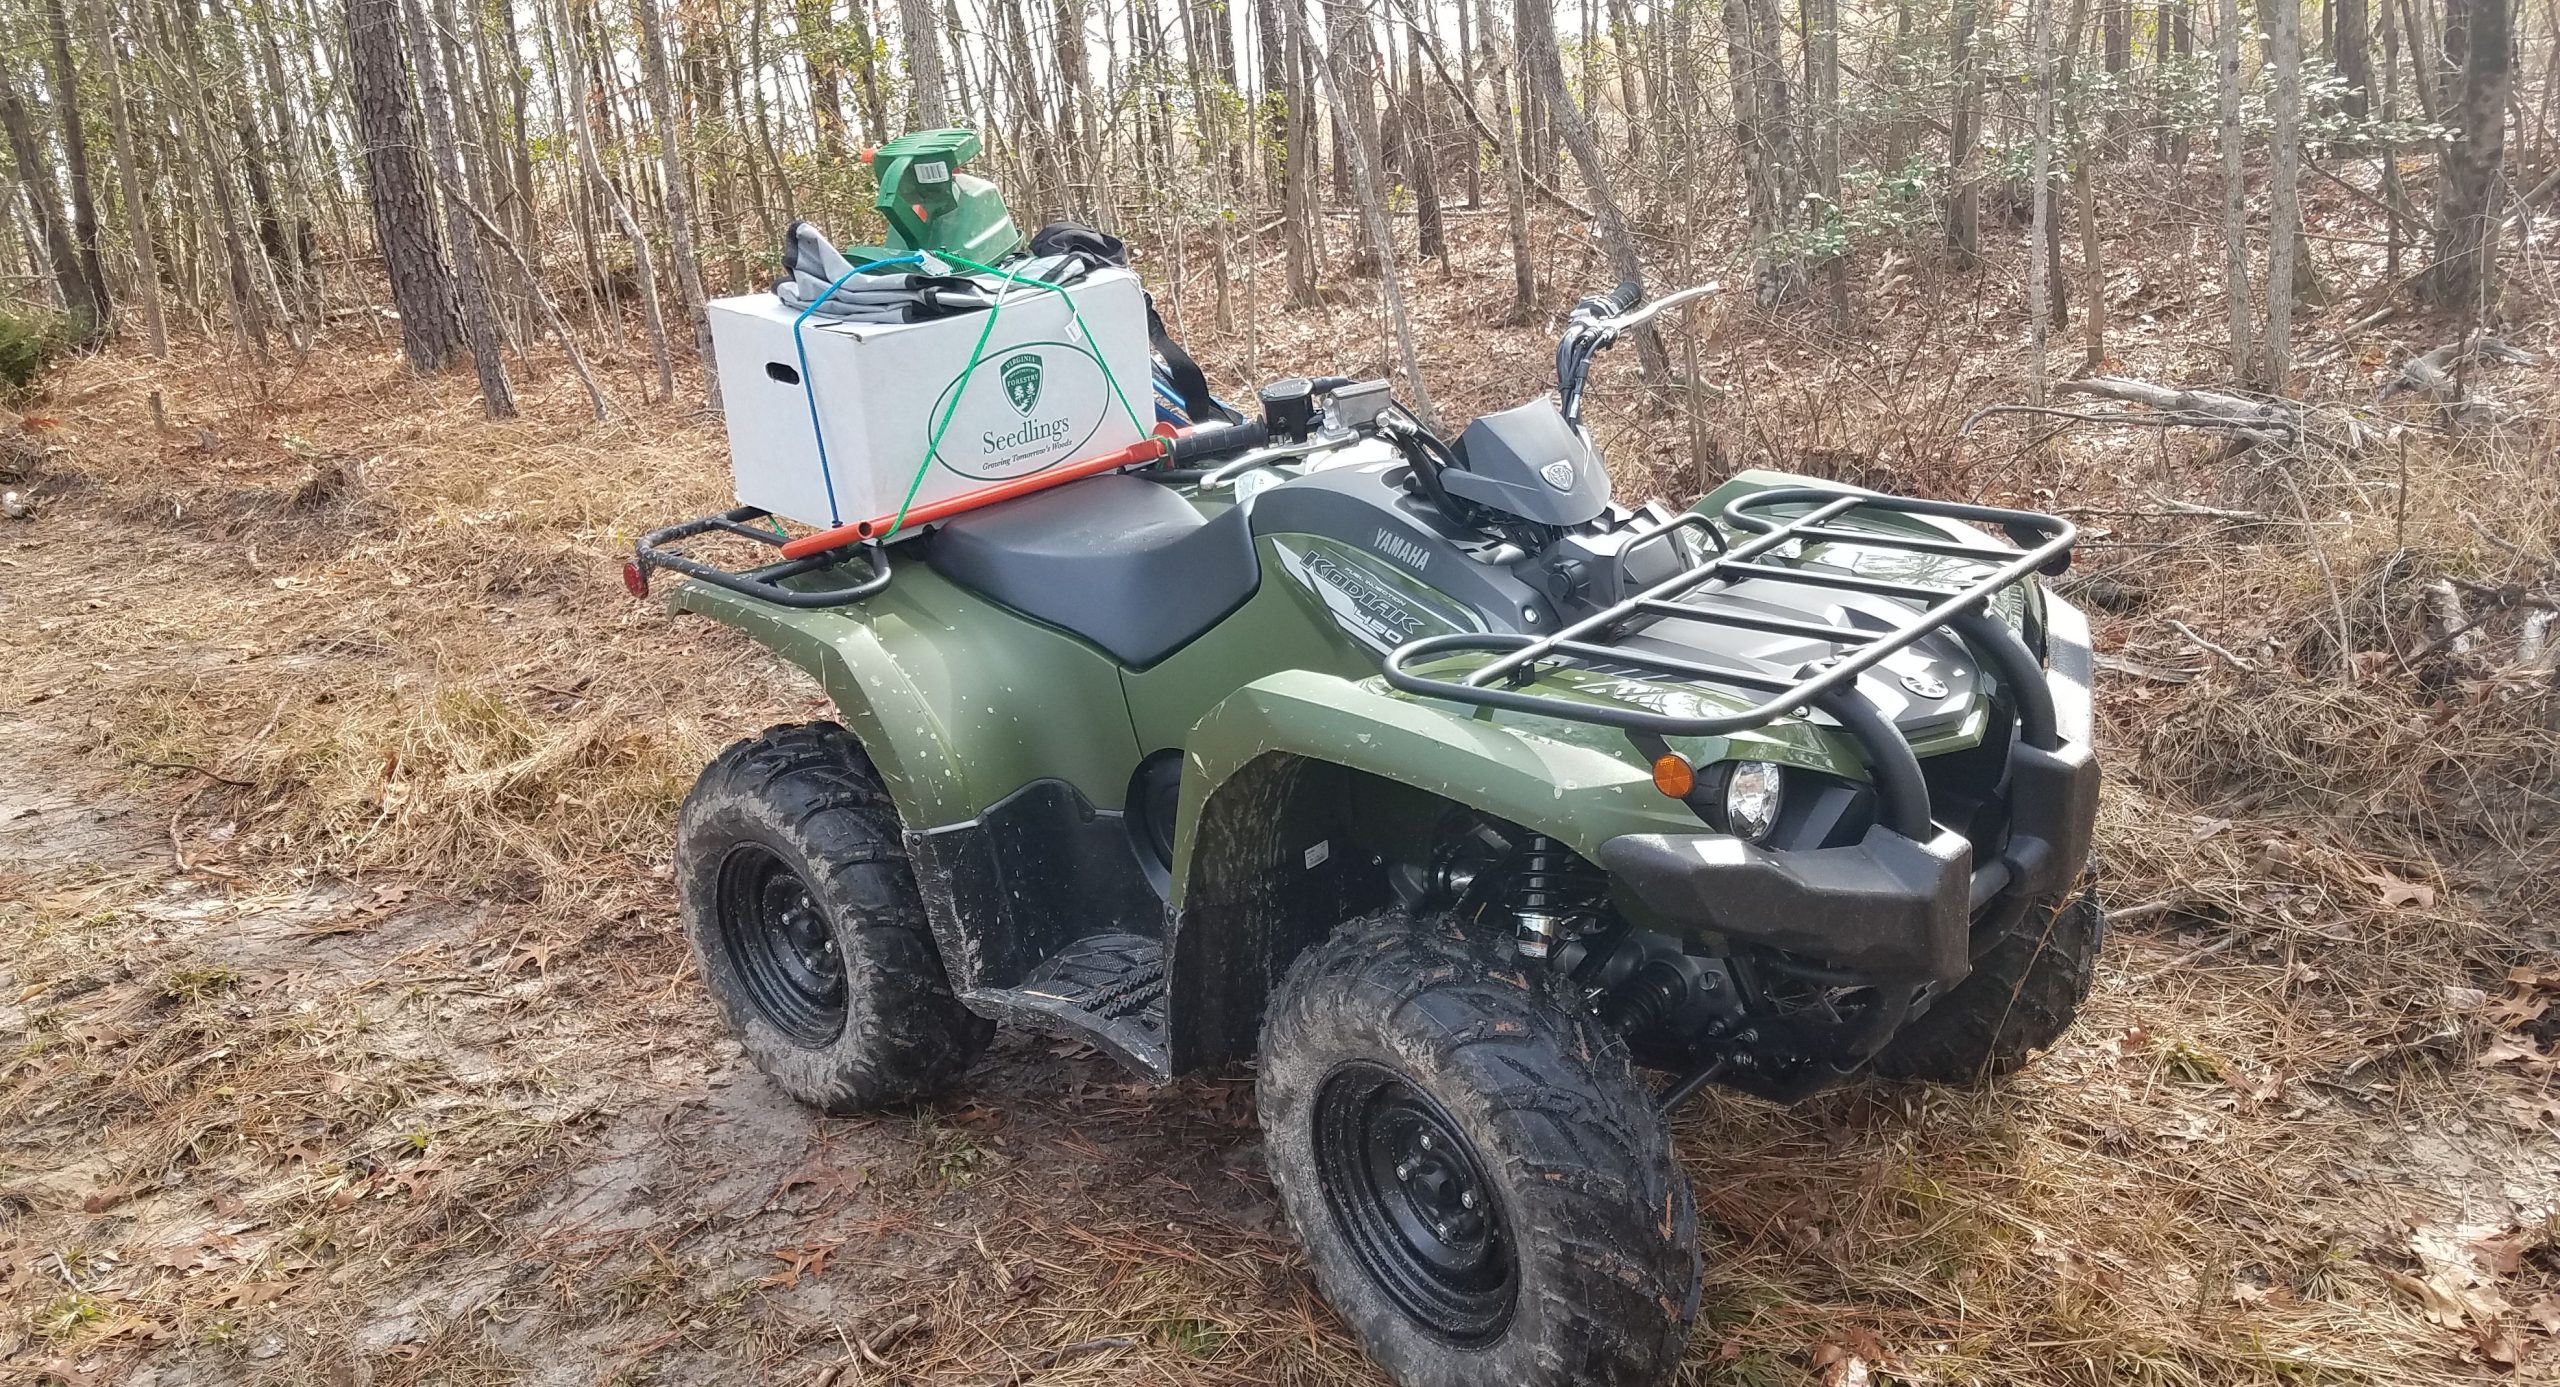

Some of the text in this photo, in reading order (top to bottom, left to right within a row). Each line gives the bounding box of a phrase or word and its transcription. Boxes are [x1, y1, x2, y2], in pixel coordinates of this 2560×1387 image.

[1005, 355, 1036, 369] VIRGINIA
[1006, 373, 1039, 388] FORESTRY
[982, 438, 1073, 471] Growing Tomorrow's Woods
[983, 417, 1070, 455] Seedlings
[1373, 528, 1431, 571] YAMAHA
[1299, 550, 1426, 635] KODIAK
[1344, 567, 1407, 607] FUEL INJECTION
[1355, 608, 1404, 644] 450
